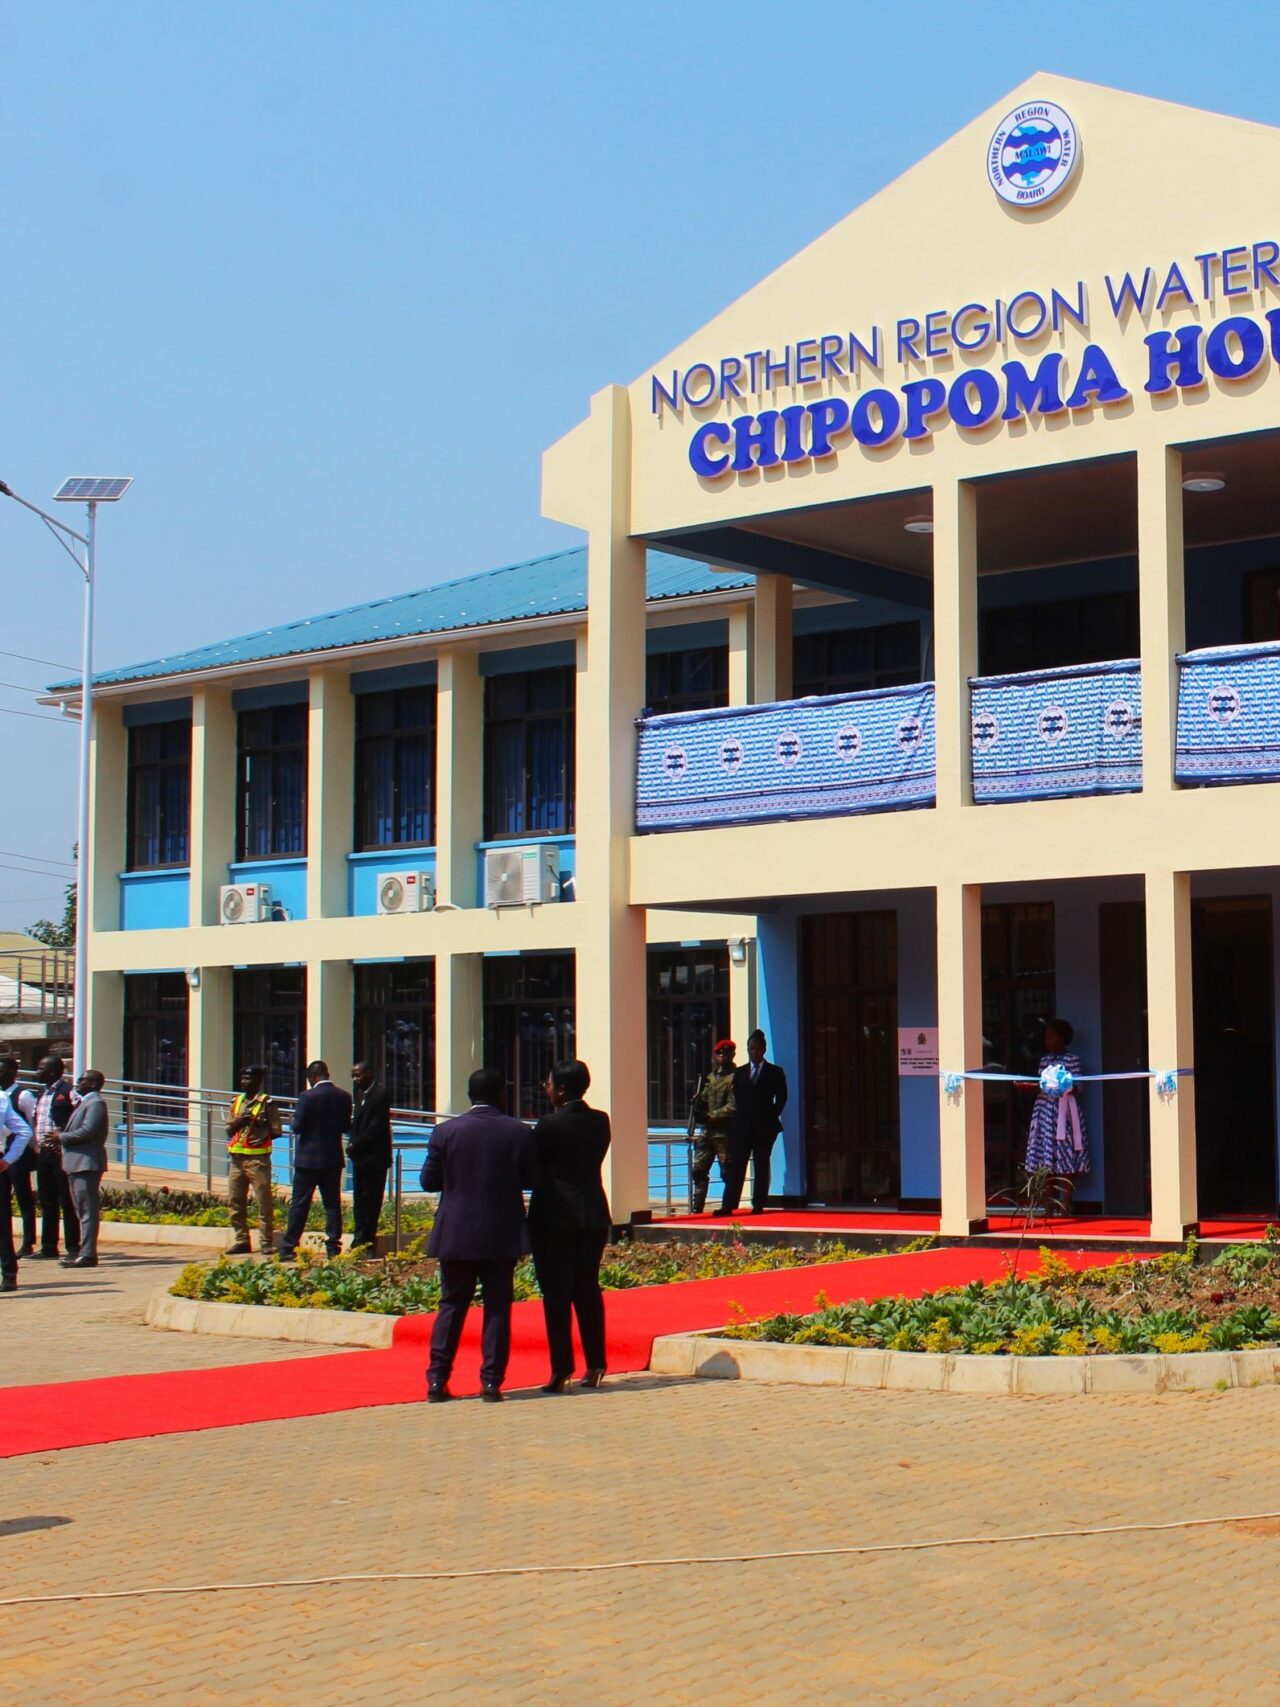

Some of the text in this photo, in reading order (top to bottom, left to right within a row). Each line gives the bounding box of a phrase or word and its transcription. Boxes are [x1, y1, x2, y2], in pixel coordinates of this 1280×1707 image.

[991, 106, 1072, 200] NORTHERN REGION WATER BOARD
[1014, 145, 1053, 161] MALAWI
[651, 325, 878, 414] NORTHERN
[897, 280, 1087, 363] REGION
[688, 344, 1132, 478] CHIPOPOMA
